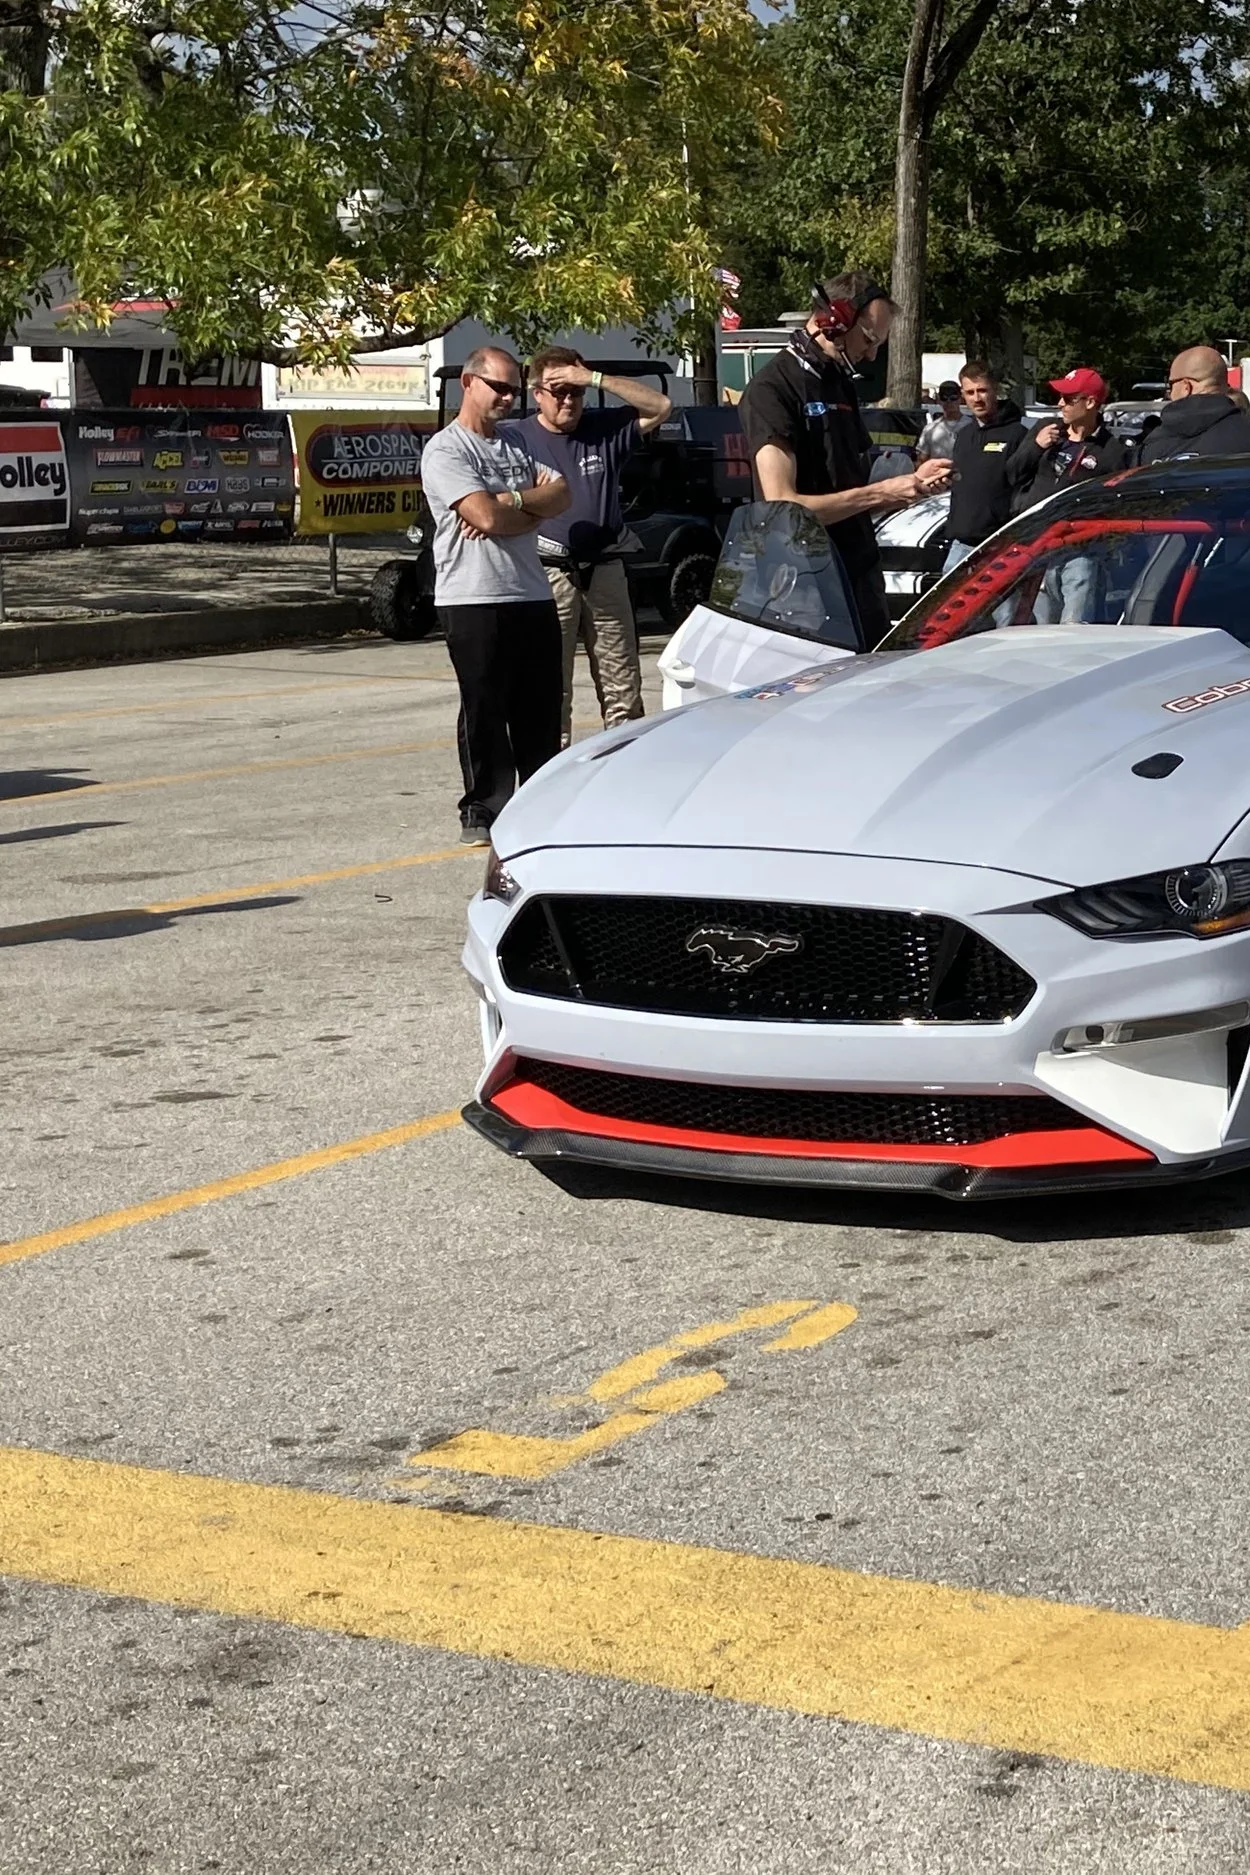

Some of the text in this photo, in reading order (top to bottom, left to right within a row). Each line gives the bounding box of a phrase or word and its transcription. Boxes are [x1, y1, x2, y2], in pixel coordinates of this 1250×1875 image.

[78, 426, 115, 441] Holley
[247, 430, 285, 438] HOOKER
[0, 456, 66, 496] olley
[323, 490, 397, 517] WINNERS
